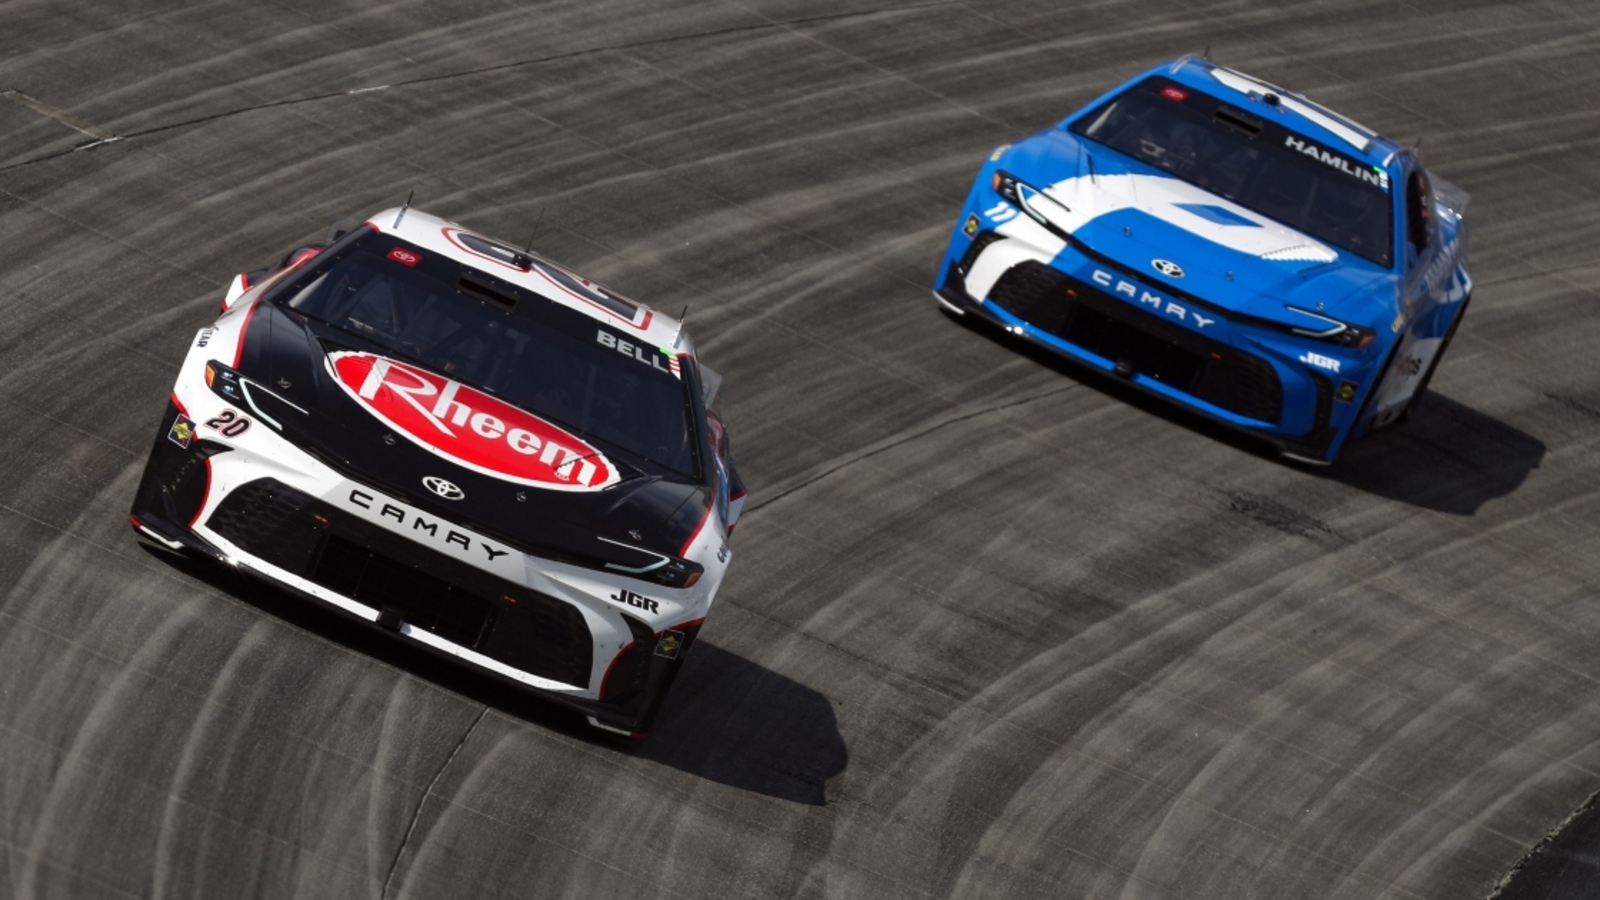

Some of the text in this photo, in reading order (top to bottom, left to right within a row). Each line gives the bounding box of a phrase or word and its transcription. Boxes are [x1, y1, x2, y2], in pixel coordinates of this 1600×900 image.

[1284, 135, 1379, 187] HAMLIN
[1091, 269, 1216, 328] CAMRY
[596, 329, 670, 374] BELL
[1298, 351, 1341, 373] JGR
[204, 409, 251, 438] 20
[358, 356, 598, 489] Rheem
[348, 489, 509, 562] CAMRY
[610, 588, 660, 615] JGR
